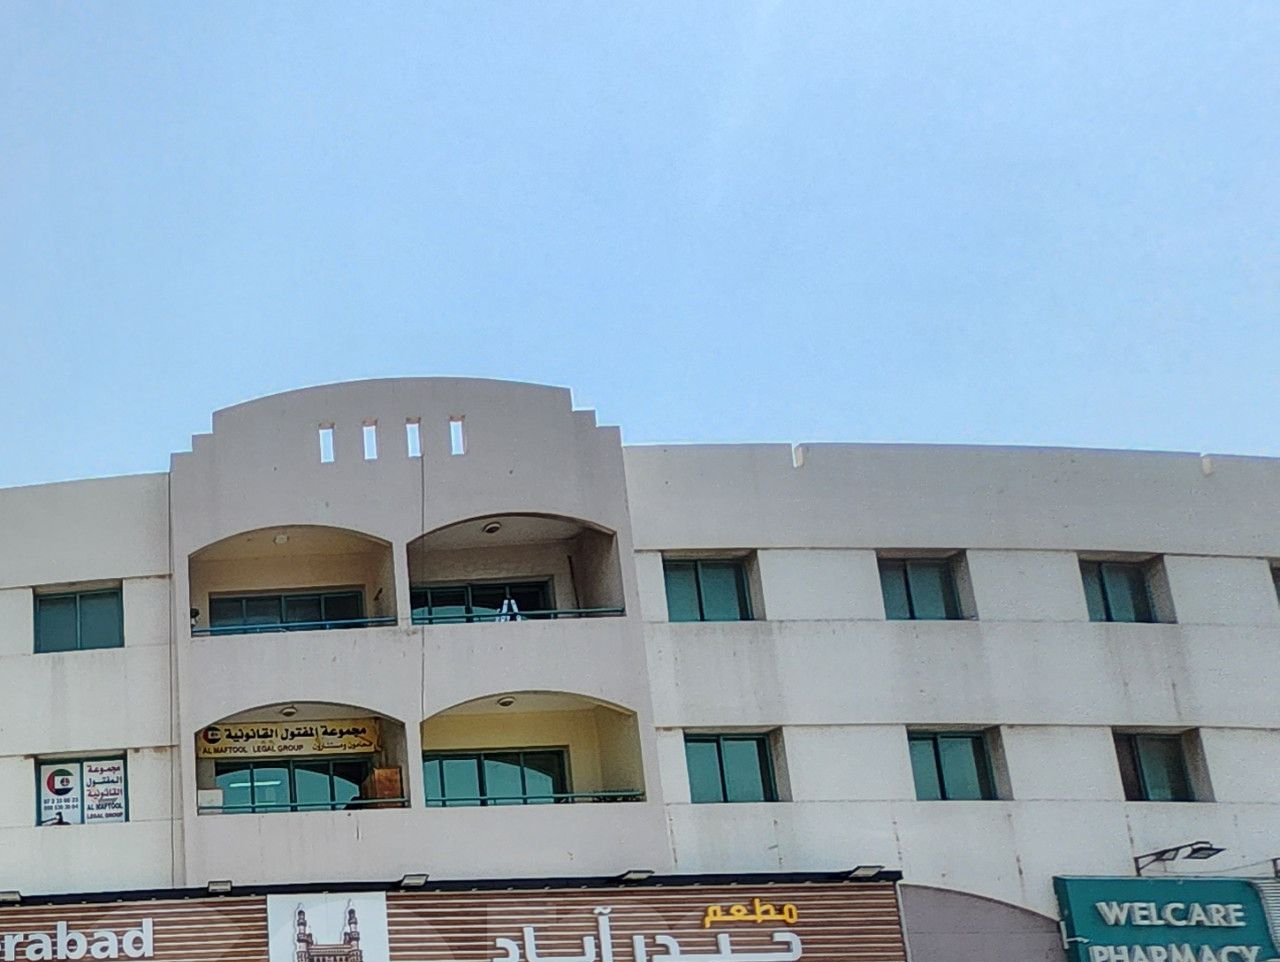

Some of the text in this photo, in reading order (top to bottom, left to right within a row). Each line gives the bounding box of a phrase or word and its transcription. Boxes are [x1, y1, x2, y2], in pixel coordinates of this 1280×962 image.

[223, 725, 367, 742] مجموعة المفتول القانونية
[277, 744, 304, 753] GROUP
[703, 897, 799, 929] مطعم
[1095, 901, 1247, 927] WELCARE
